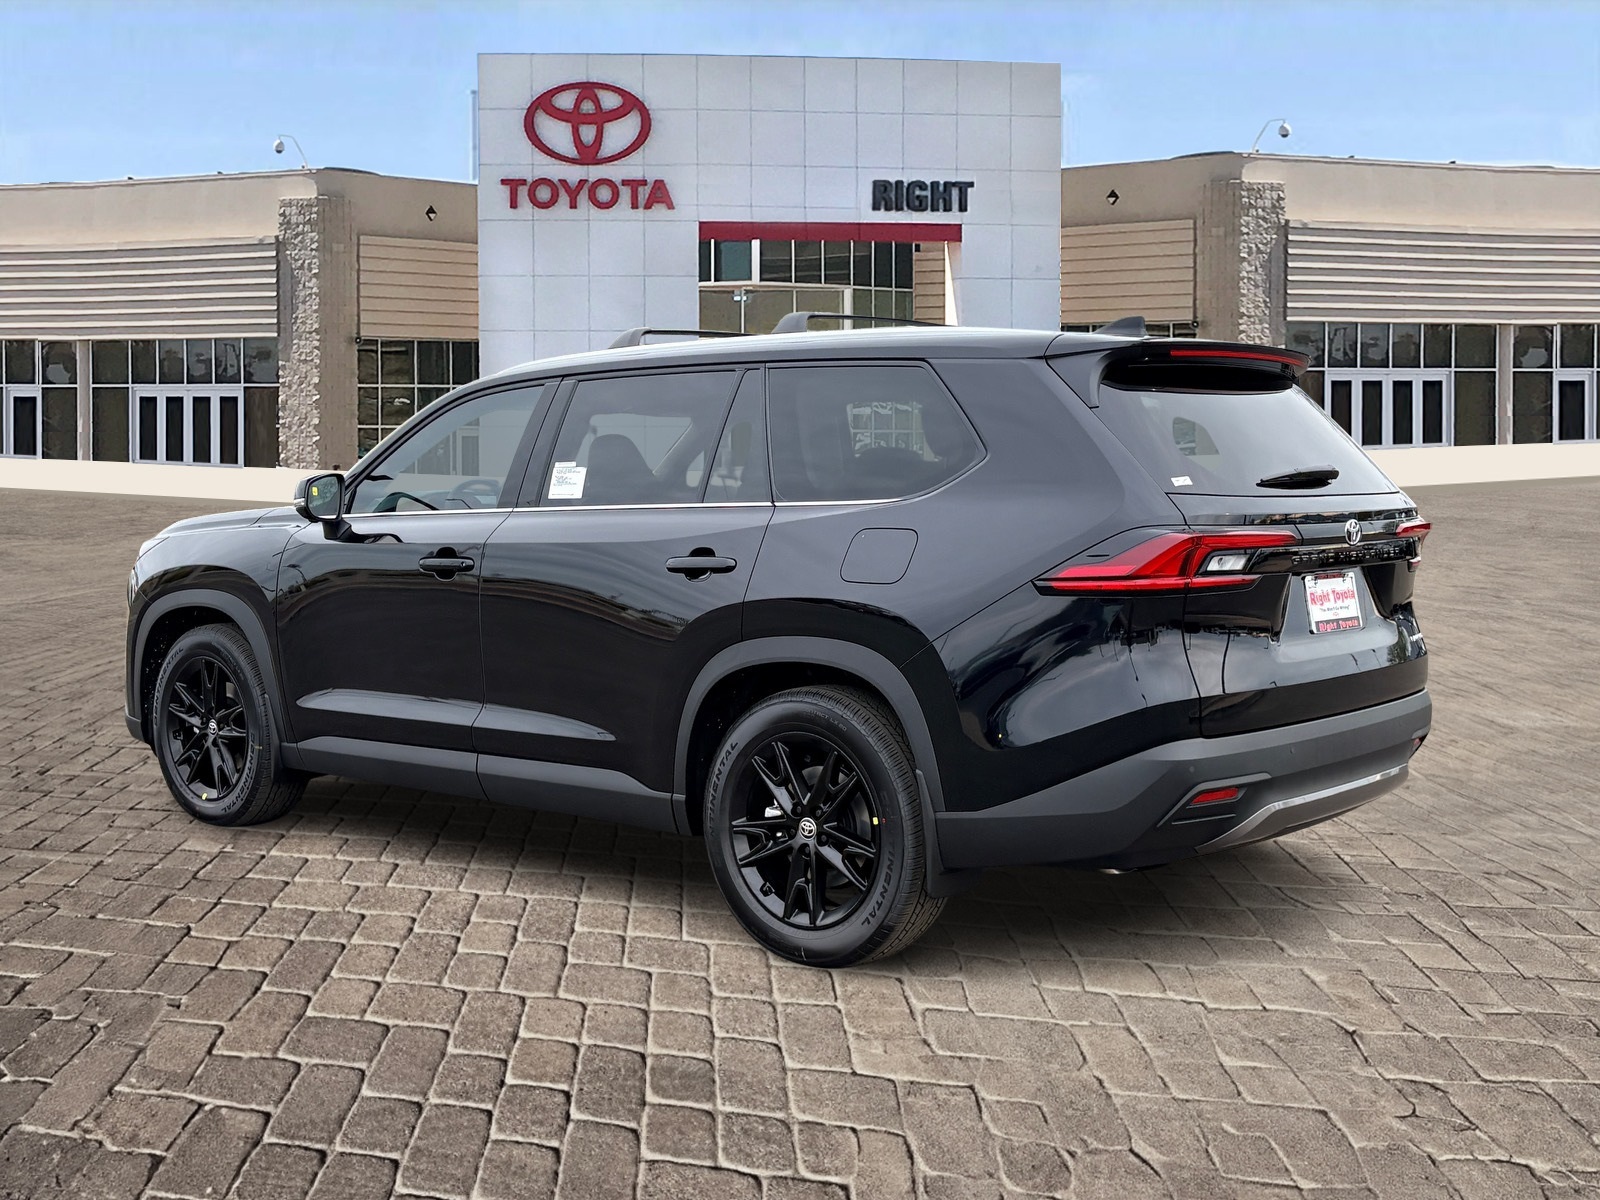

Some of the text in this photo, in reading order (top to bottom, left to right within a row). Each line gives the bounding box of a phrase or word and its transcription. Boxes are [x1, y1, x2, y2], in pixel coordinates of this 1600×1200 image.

[500, 179, 675, 210] TOYOTA
[871, 179, 975, 213] RIGHT
[1309, 588, 1356, 606] Right Toyota
[1319, 619, 1358, 632] Right Toyota
[154, 647, 184, 727] CONTINENTAL
[221, 732, 256, 813] CONTINENTAL
[709, 741, 739, 837] NTINENTAL
